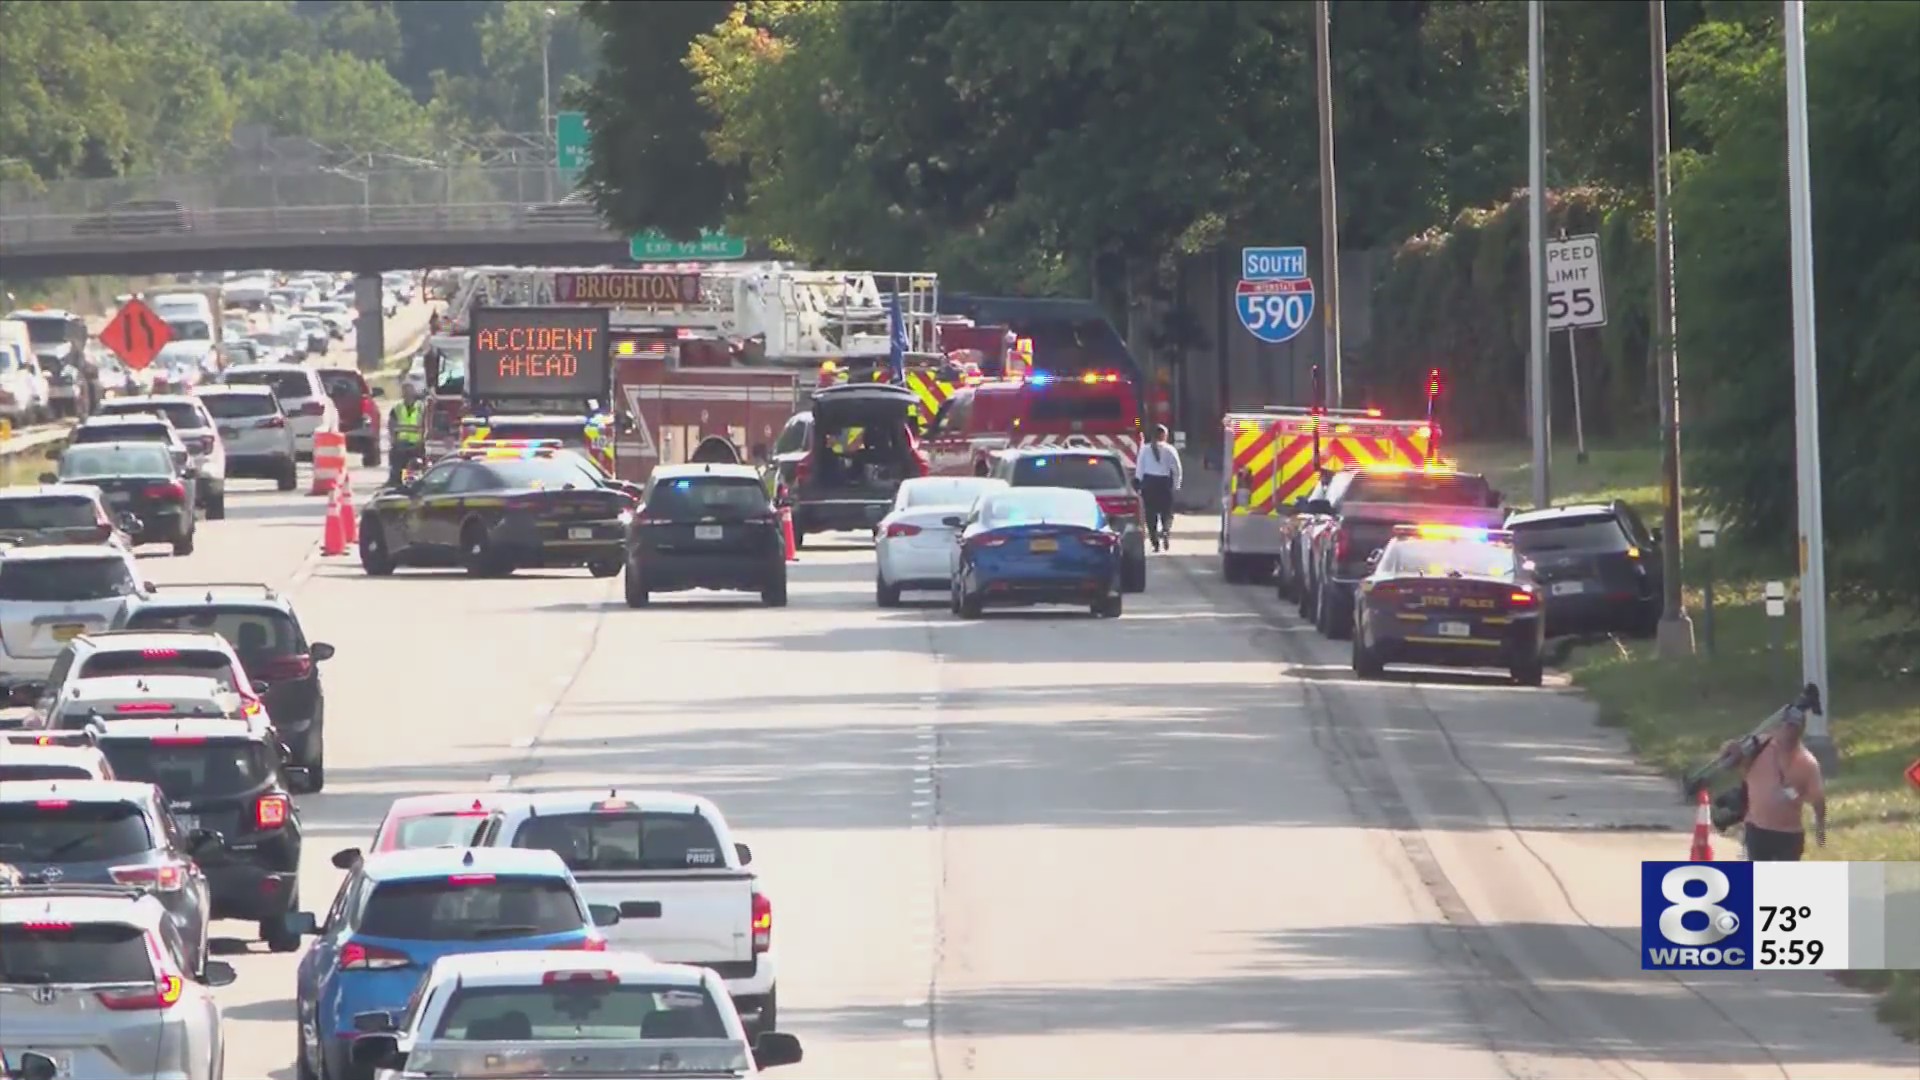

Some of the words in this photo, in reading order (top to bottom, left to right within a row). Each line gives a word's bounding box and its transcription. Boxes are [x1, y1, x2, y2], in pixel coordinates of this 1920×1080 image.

[1248, 254, 1303, 274] SOUTH
[1549, 246, 1594, 262] PEED
[575, 275, 679, 299] BRIGHTON
[1248, 295, 1304, 330] 590
[1548, 288, 1594, 319] 55
[478, 327, 598, 351] ACCIDENT
[499, 354, 577, 377] AHEAD
[1421, 596, 1449, 607] STATE
[1460, 598, 1495, 609] POLICE
